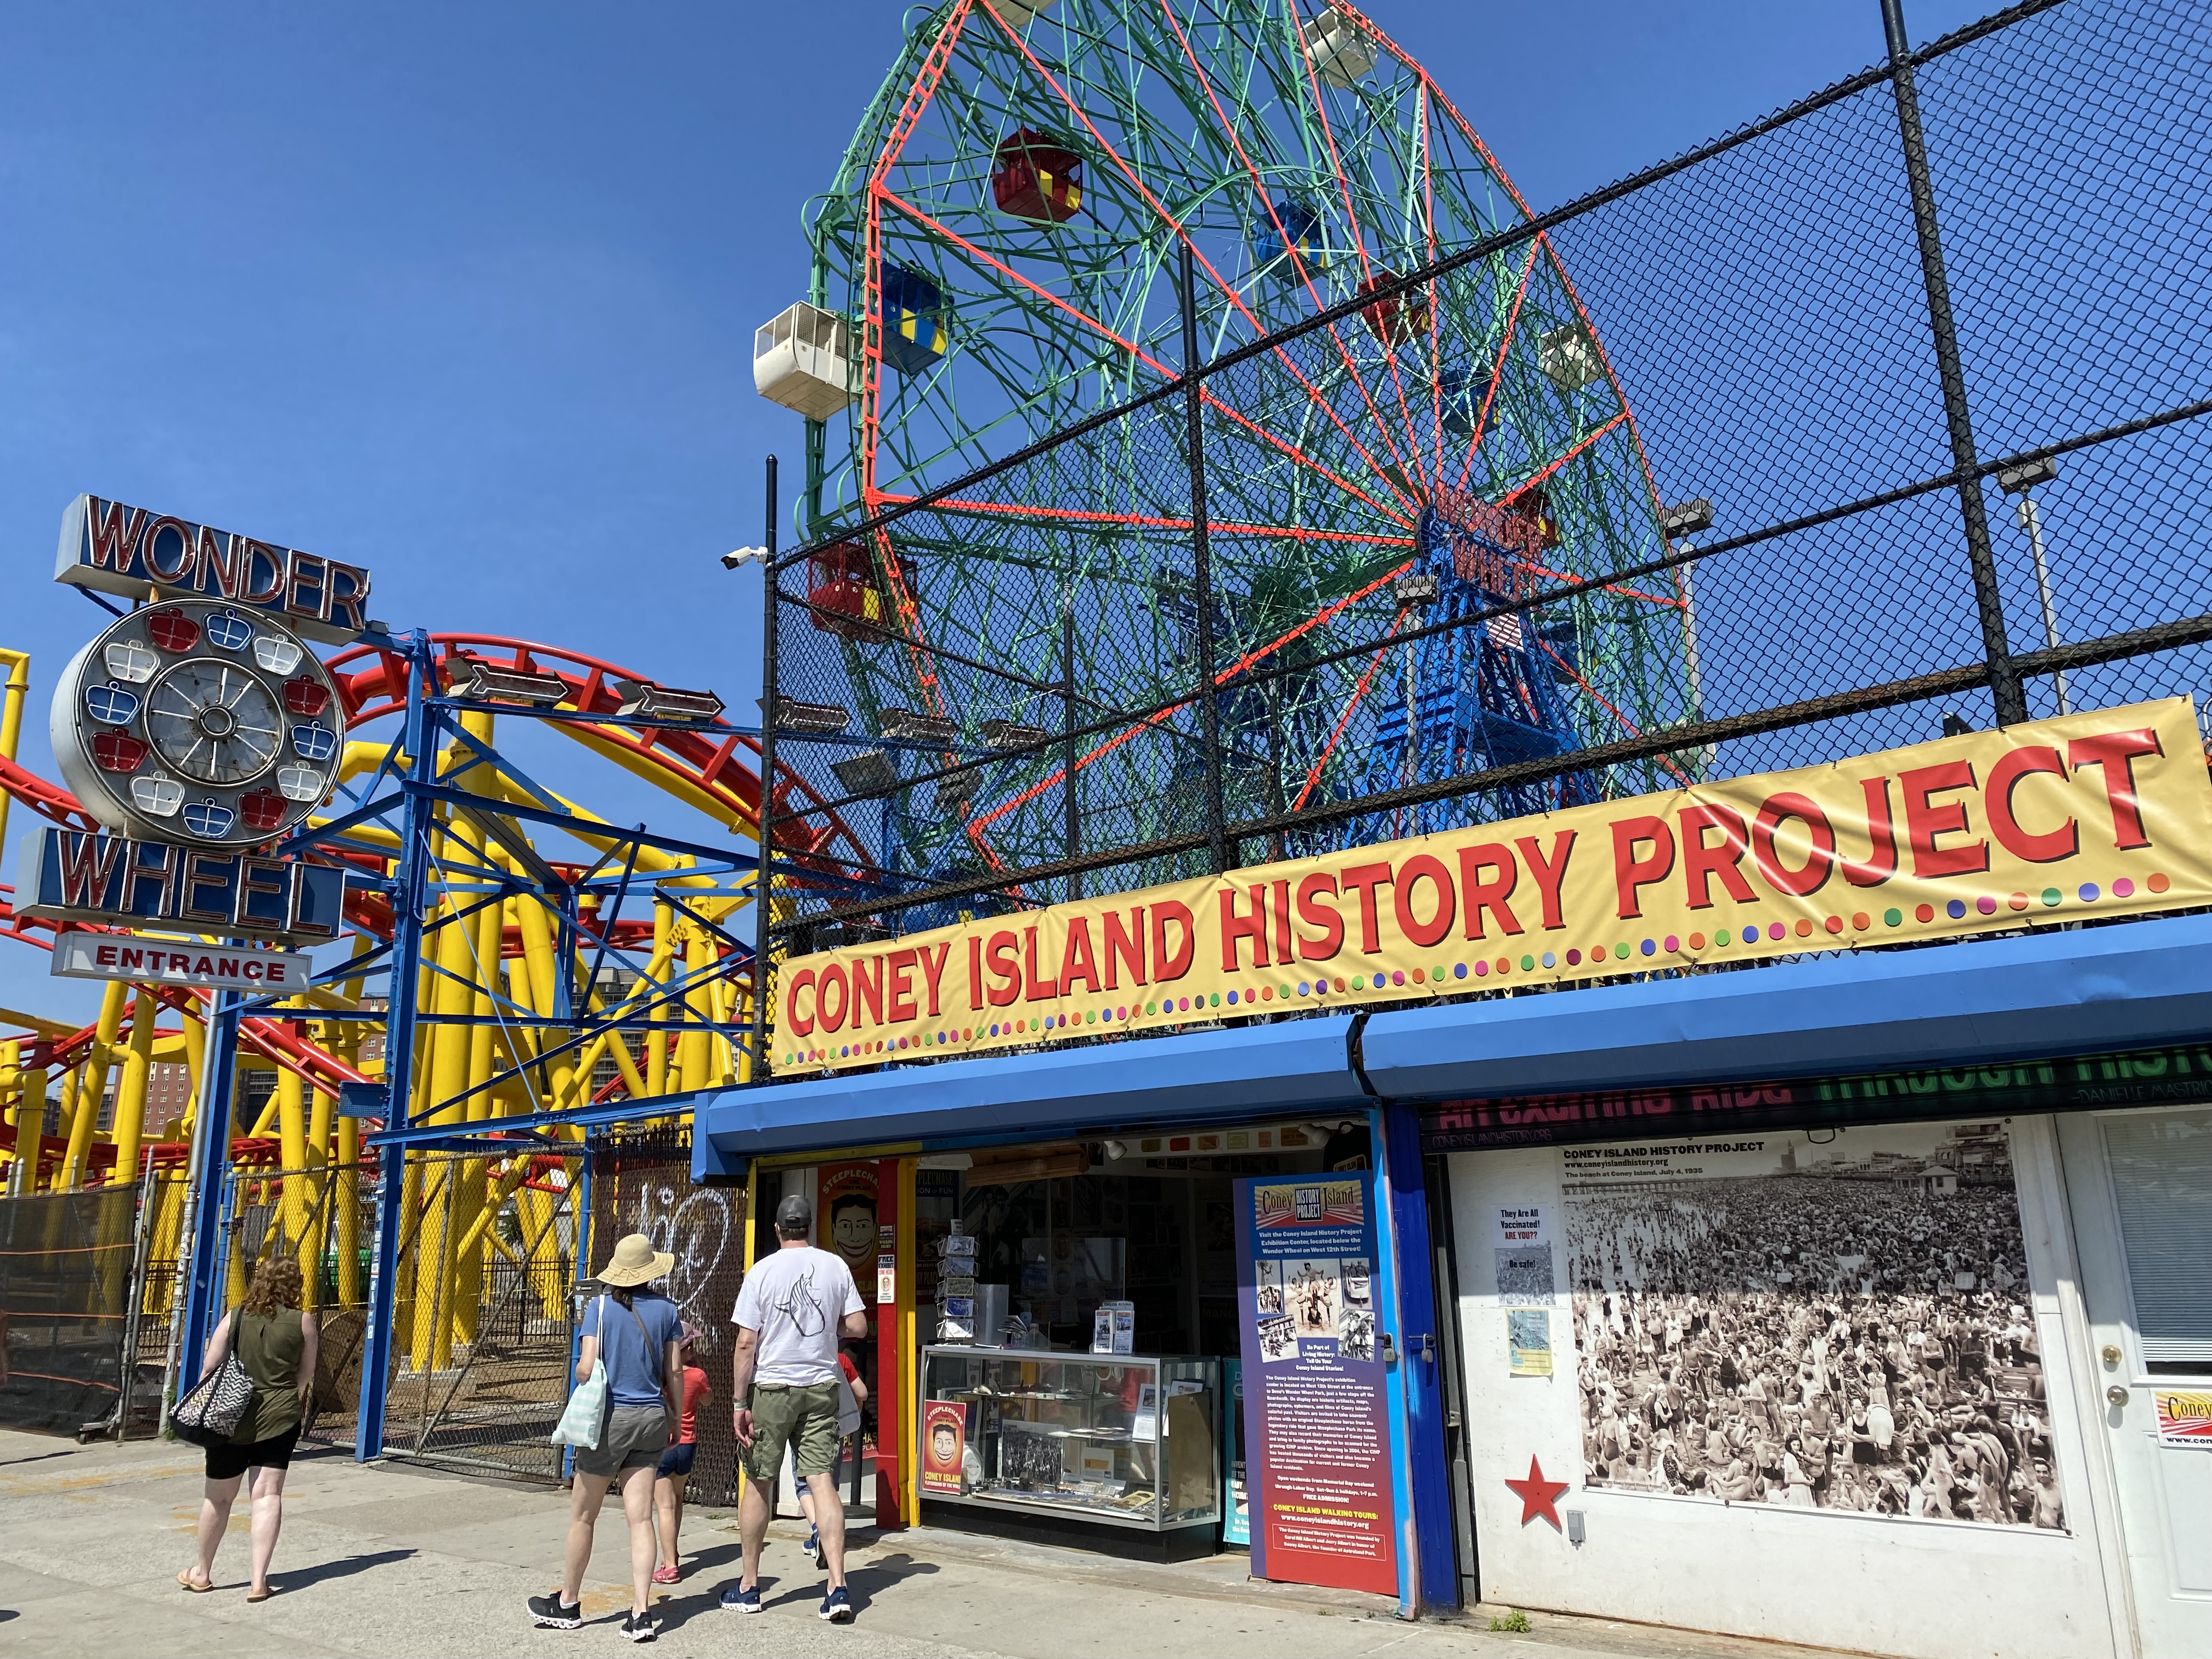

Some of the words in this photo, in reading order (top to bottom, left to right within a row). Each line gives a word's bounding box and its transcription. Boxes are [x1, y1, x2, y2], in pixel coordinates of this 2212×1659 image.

[86, 494, 369, 628] WONDER
[57, 831, 332, 934] WHEEL
[787, 942, 950, 1037] CONEY
[967, 900, 1194, 1006] ISLAND
[1218, 829, 1578, 973] HISTORY
[1609, 727, 2165, 920] PROJECT
[97, 945, 285, 981] ENTRANCE
[1564, 1149, 1602, 1159] CONEY
[1604, 1147, 1647, 1158] ISLAND
[1650, 1144, 1703, 1155] HISTORY
[1705, 1142, 1764, 1153] PROJECT
[1565, 1158, 1668, 1168] www.coneyislandhistory.org
[823, 1169, 879, 1194] STEEPLECHA
[917, 1171, 953, 1186] PLECHASE
[1262, 1190, 1293, 1214] Coney
[1295, 1189, 1319, 1204] HISTORY
[1323, 1187, 1353, 1211] Island
[1297, 1204, 1320, 1218] PROJECT
[1500, 1210, 1516, 1220] They
[1518, 1209, 1529, 1217] Are
[1530, 1209, 1538, 1217] All
[1500, 1220, 1541, 1228] Vaccinated!
[1505, 1231, 1517, 1240] ARE
[1517, 1231, 1538, 1240] YOU??
[1509, 1260, 1518, 1268] Be
[1519, 1260, 1536, 1268] safe!
[927, 1407, 963, 1426] STEEPLECHASE
[2168, 1397, 2212, 1421] Coney
[925, 1471, 943, 1482] CONEY
[1296, 1505, 1321, 1515] ISLAND
[1321, 1508, 1353, 1518] WALKING
[1353, 1511, 1379, 1520] TOURS:
[1280, 1514, 1369, 1530] www.coneyislandhistory.org
